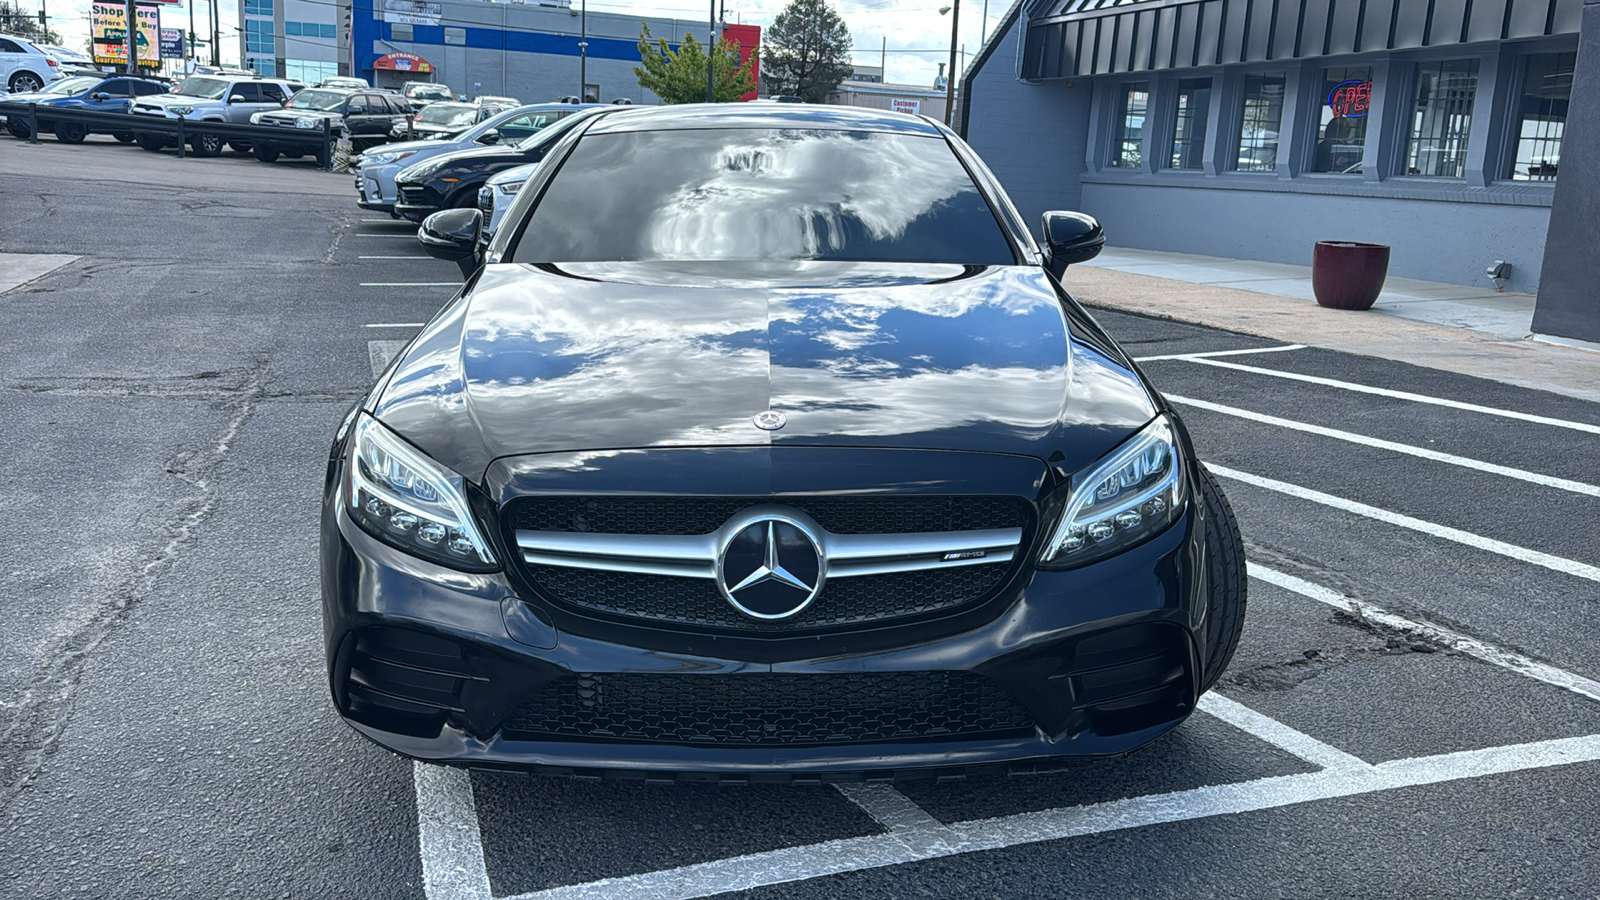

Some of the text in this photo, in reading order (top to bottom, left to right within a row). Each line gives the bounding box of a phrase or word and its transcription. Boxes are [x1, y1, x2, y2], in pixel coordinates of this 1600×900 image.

[92, 4, 156, 18] Shop ere
[94, 18, 120, 26] Before
[94, 54, 158, 68] Guarantee avings
[388, 53, 419, 61] ENTRANCE
